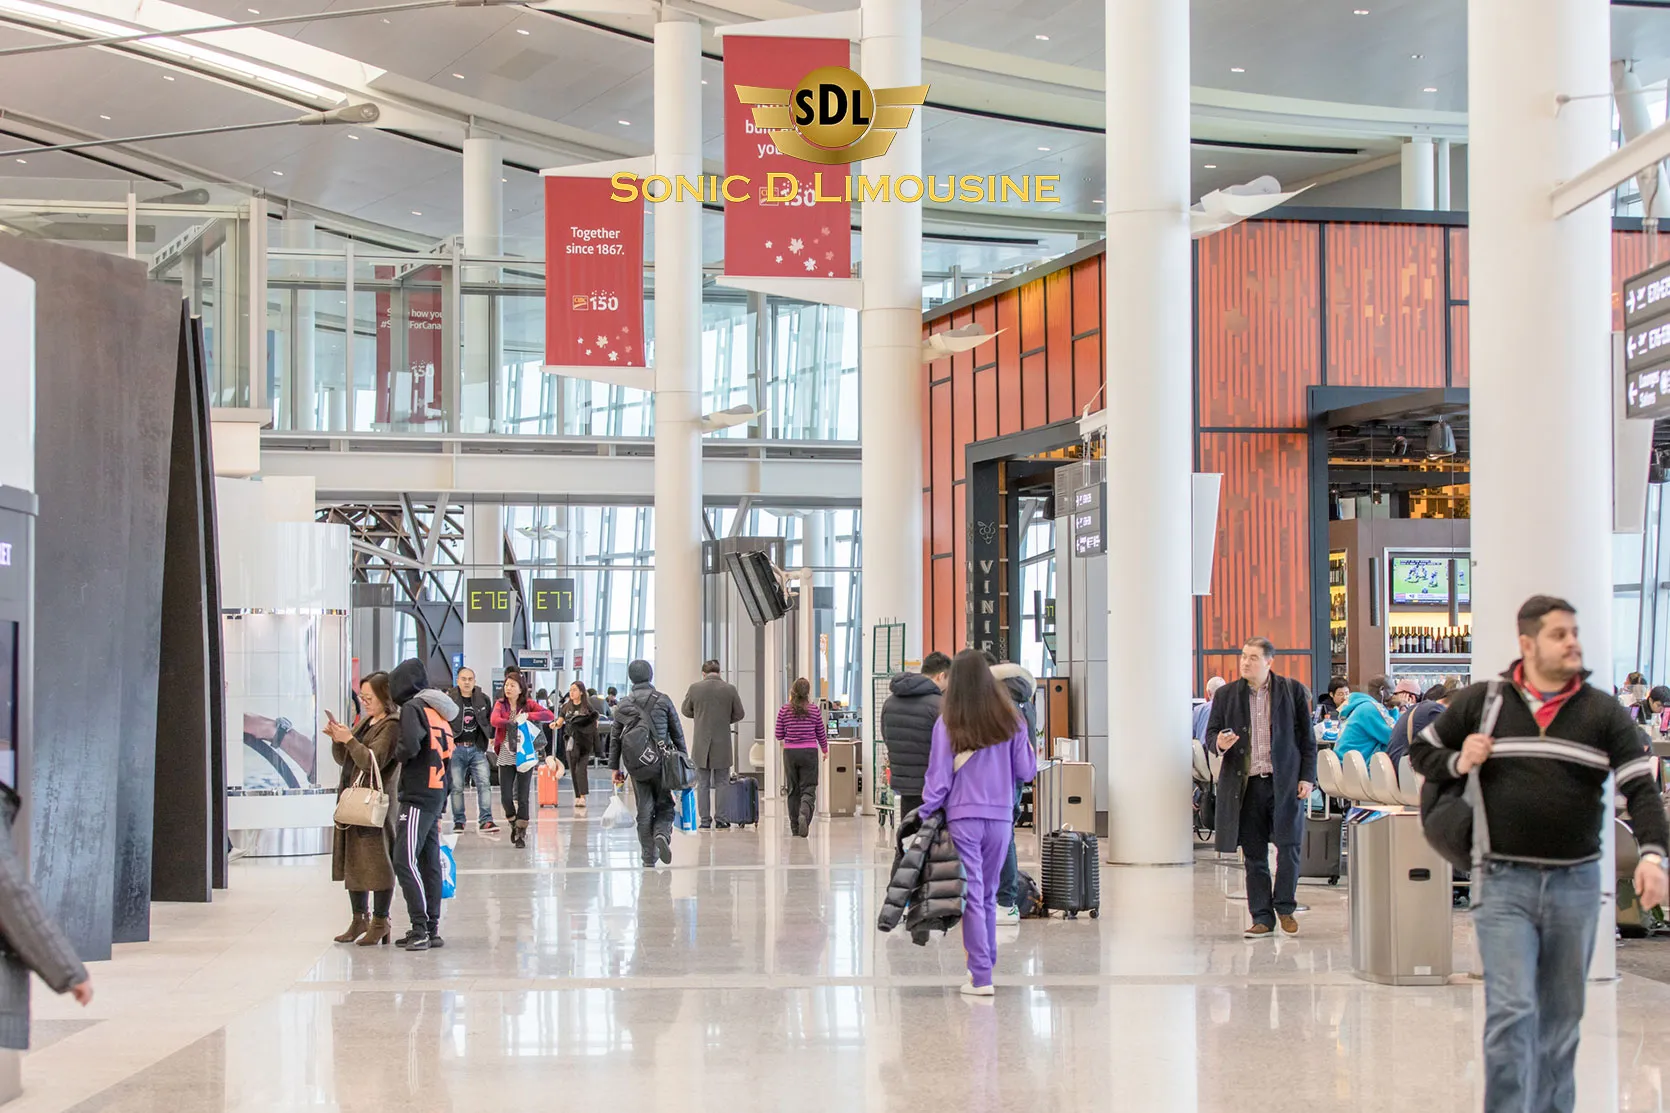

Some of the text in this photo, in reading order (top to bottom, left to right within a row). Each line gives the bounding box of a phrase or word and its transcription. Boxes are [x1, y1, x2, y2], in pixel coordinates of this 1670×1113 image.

[570, 226, 621, 242] Together
[566, 243, 625, 256] since 1867.
[589, 294, 619, 311] 150
[411, 308, 429, 318] how
[471, 591, 508, 610] E76
[536, 591, 572, 610] E77
